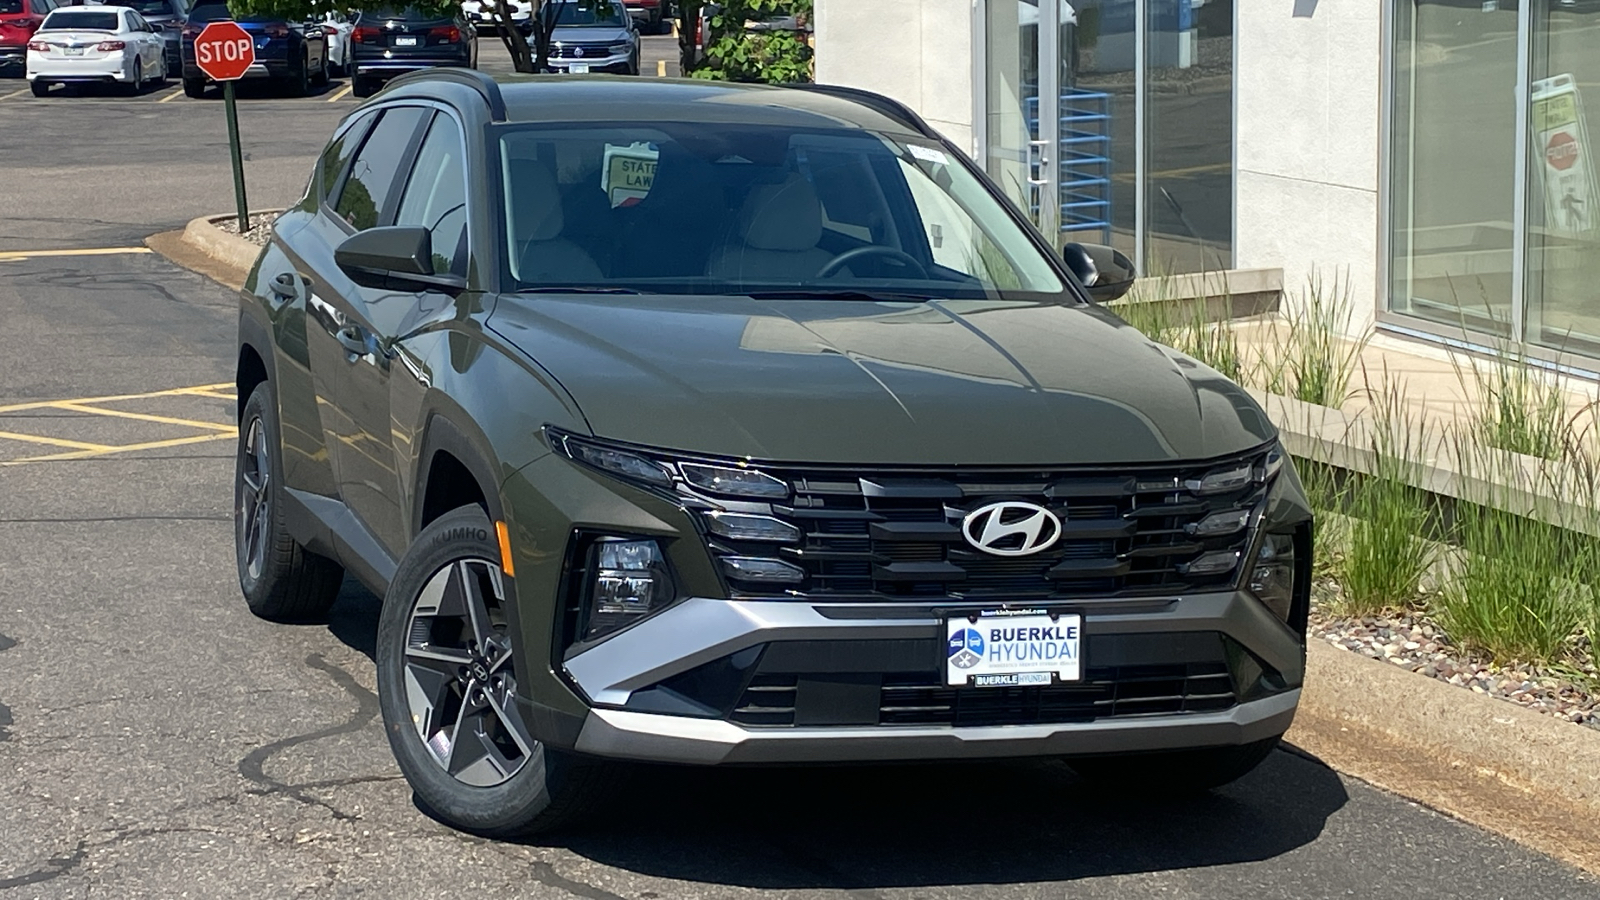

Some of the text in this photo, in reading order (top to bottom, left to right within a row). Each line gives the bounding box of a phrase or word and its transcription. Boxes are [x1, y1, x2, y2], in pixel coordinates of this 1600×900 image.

[199, 39, 250, 63] STOP
[626, 174, 651, 187] LAW
[432, 527, 487, 546] KUMHO
[990, 626, 1078, 642] BUERKLE
[989, 641, 1077, 662] HYUNDAI
[976, 674, 1049, 685] BUERKLE HYUNDAI
